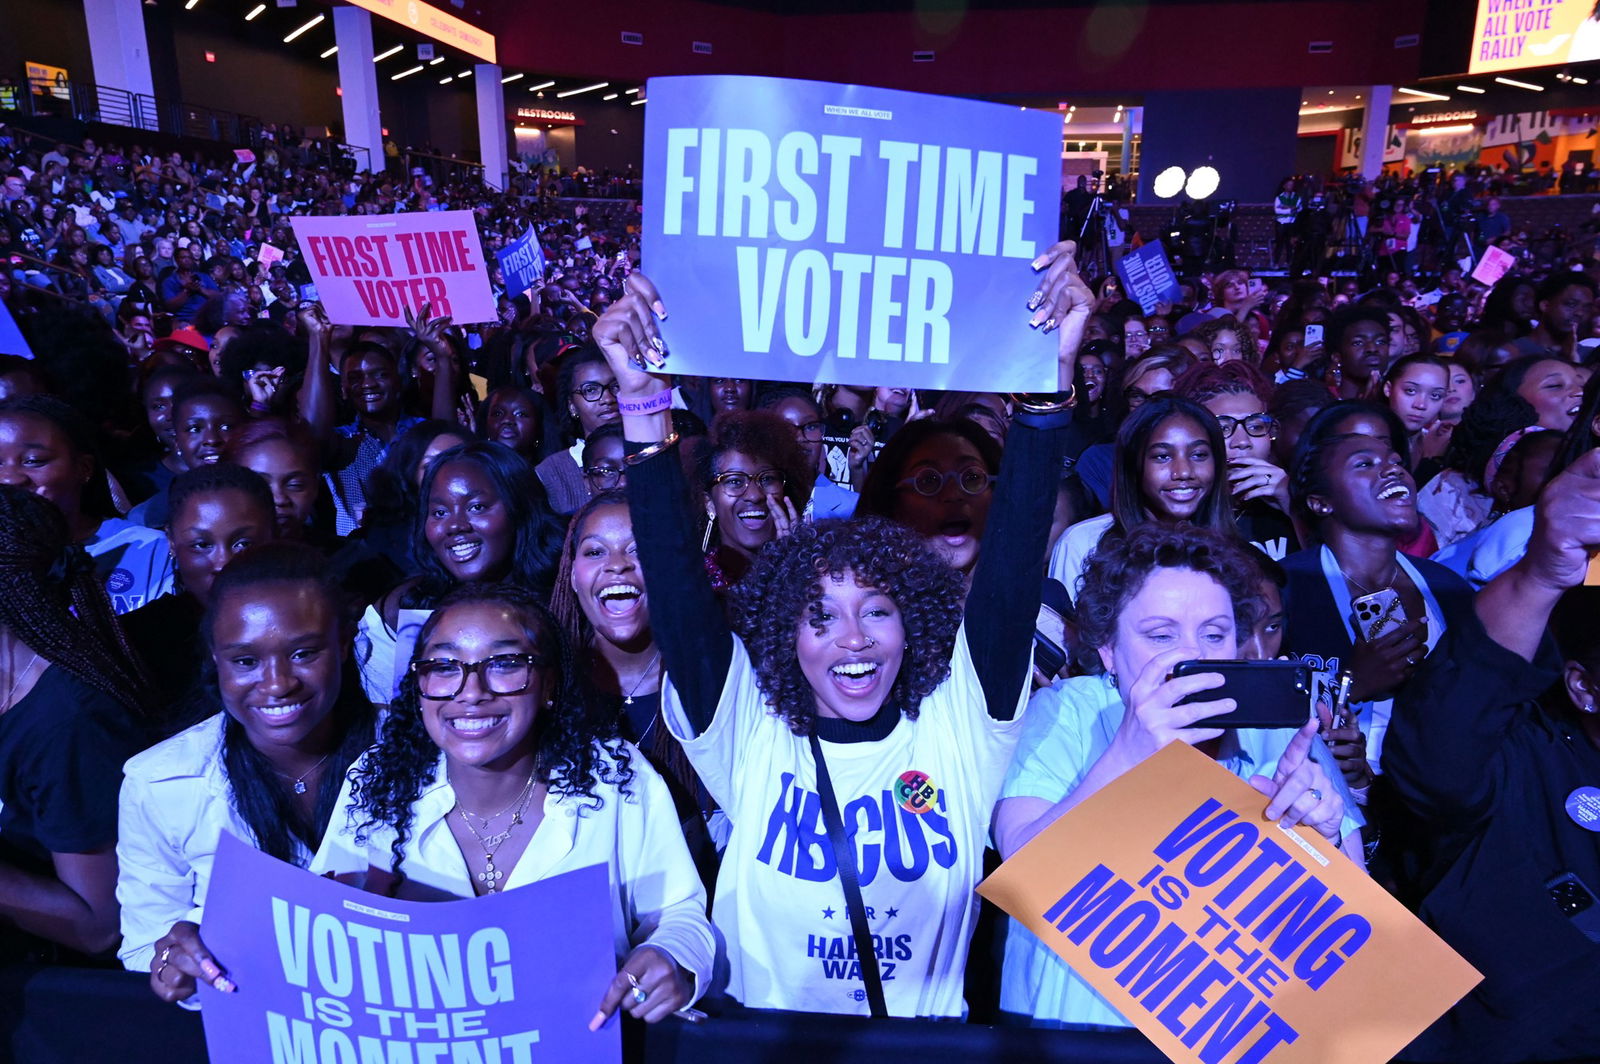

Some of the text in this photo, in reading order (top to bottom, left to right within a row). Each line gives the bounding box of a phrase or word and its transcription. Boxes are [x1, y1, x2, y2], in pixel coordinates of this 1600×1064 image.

[1483, 8, 1553, 38] ALL VOTE
[1479, 35, 1527, 62] RALLY
[518, 108, 576, 120] RESTROOMS
[825, 106, 848, 114] WHEN
[861, 110, 873, 118] ALL
[1411, 111, 1478, 124] RESTROOMS
[663, 127, 1038, 260] FIRST TIME
[307, 235, 394, 277] FIRST
[394, 230, 476, 275] TIME
[502, 243, 533, 277] FIRST
[1144, 254, 1174, 295] VOTER
[352, 276, 453, 319] VOTER
[736, 246, 954, 364] VOTER
[1132, 279, 1160, 315] FIRST
[642, 399, 658, 410] WE
[756, 771, 958, 887] HBCUS
[1152, 797, 1372, 991] VOTING
[1137, 863, 1290, 999] IS THE
[271, 896, 515, 1010] VOTING
[822, 960, 897, 981] WAZ
[1042, 863, 1300, 1064] MOMENT
[301, 991, 489, 1039] IS THE
